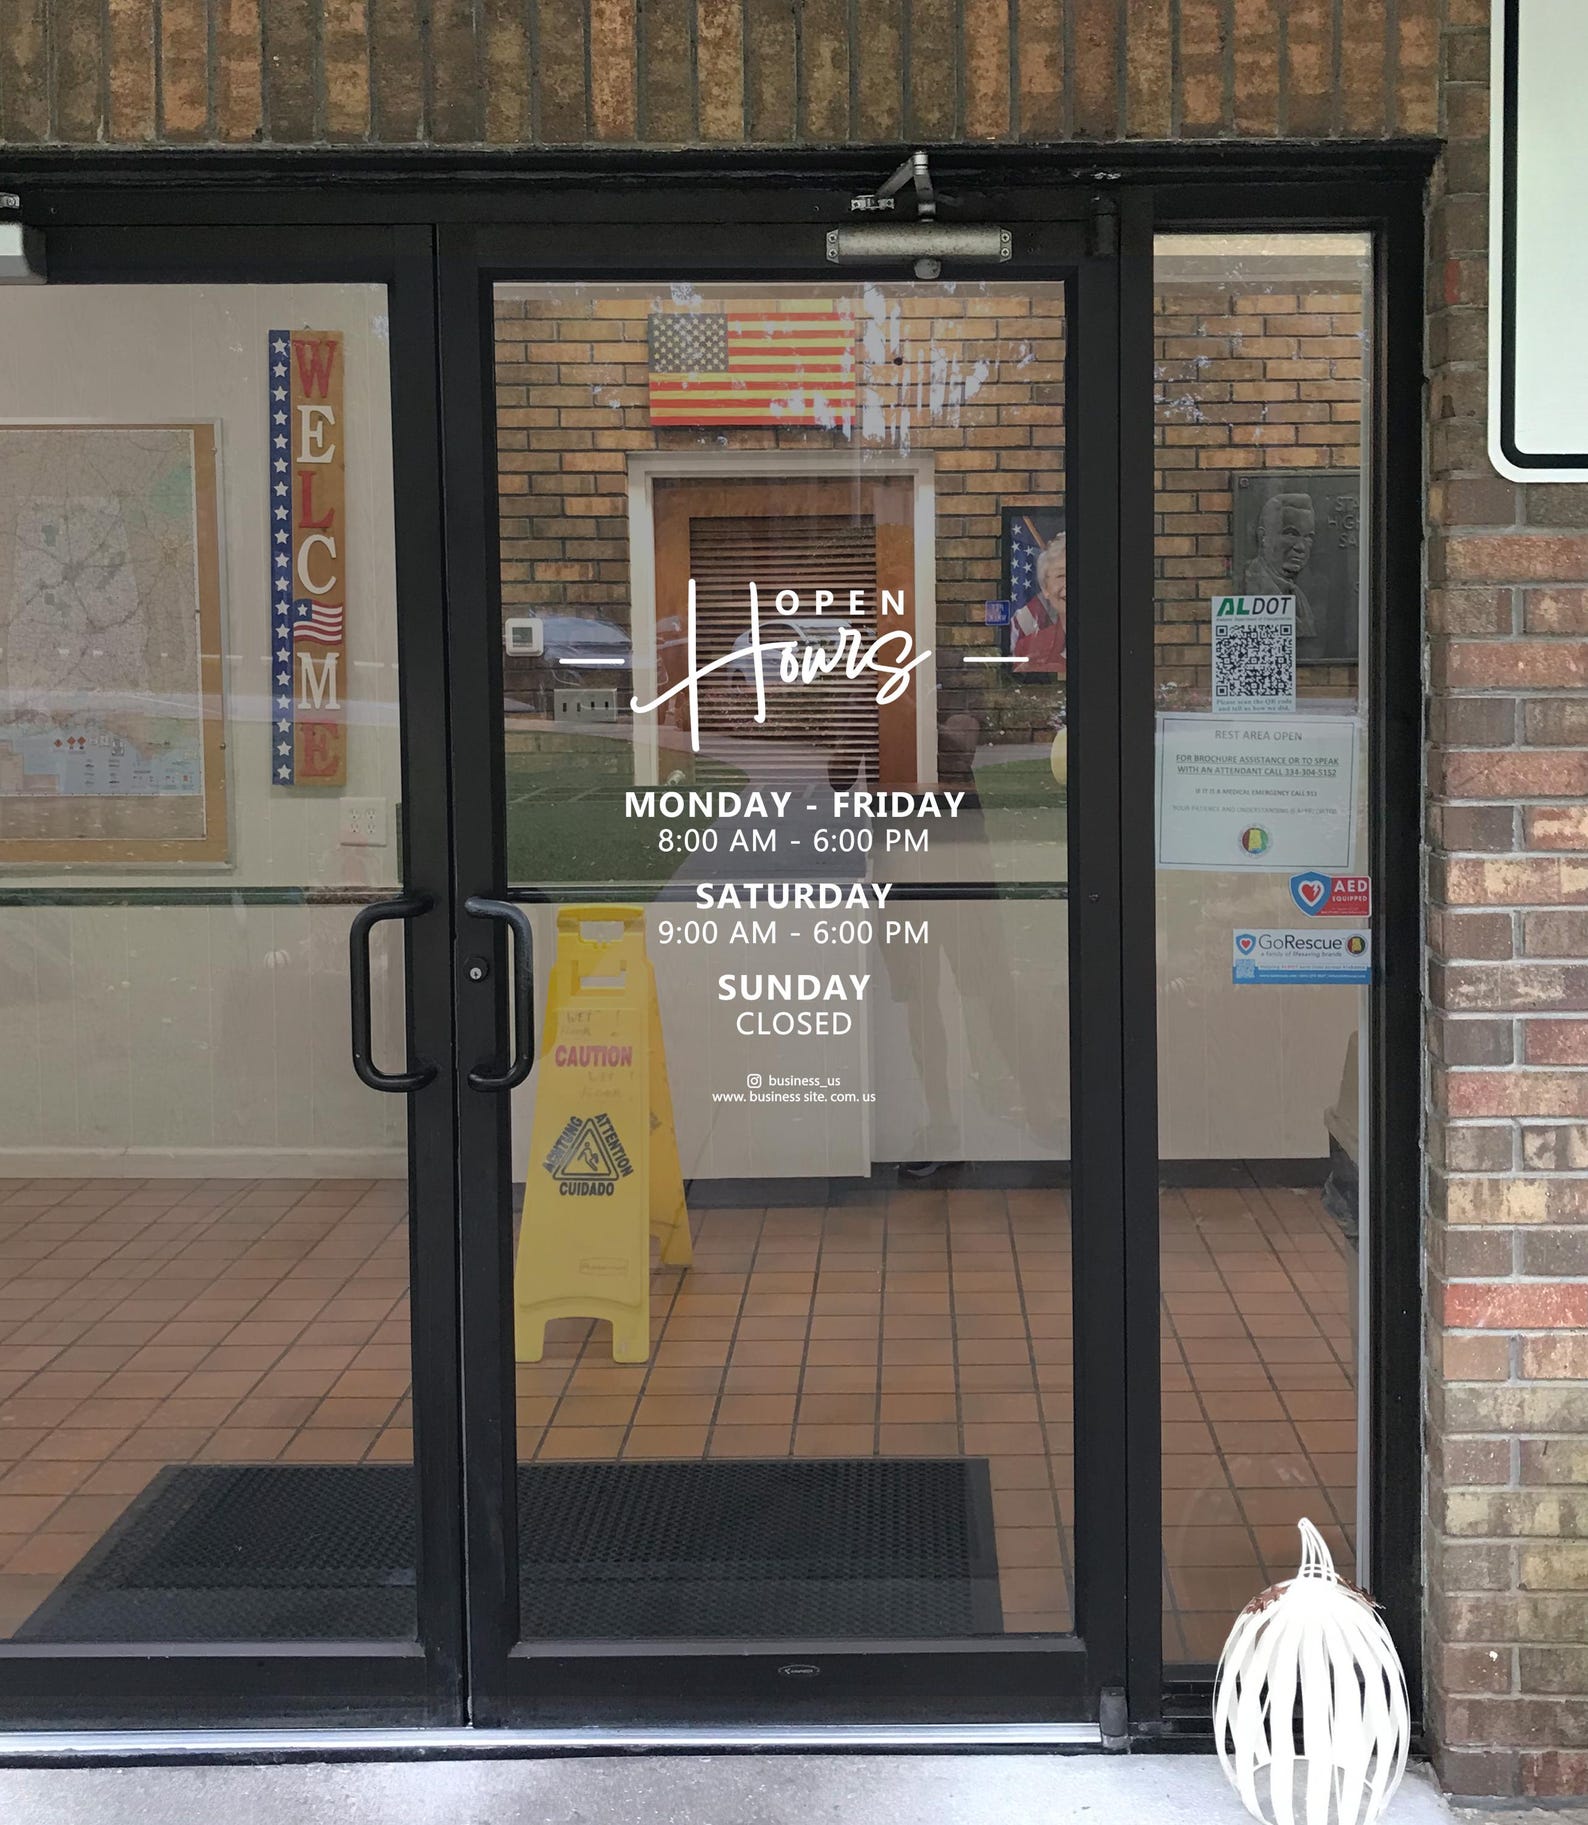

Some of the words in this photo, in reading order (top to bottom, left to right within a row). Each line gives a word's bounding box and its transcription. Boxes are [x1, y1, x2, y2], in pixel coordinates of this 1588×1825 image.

[774, 589, 905, 616] OPEN
[1216, 597, 1292, 616] ALDOT
[630, 578, 932, 752] Hours
[1215, 729, 1239, 740] REST
[1243, 730, 1270, 741] AREA
[1273, 731, 1303, 741] OPEN
[1176, 754, 1192, 762] FOR
[1194, 755, 1237, 763] BROCHURE
[1239, 756, 1286, 764] ASSISTANCE
[1302, 757, 1313, 765] TO
[1314, 757, 1339, 765] SPEAK
[1177, 765, 1199, 773] WITH
[1201, 766, 1213, 774] AN
[1215, 767, 1262, 775] ATTENDANT
[1264, 768, 1282, 776] CALL
[1251, 789, 1289, 797] EMERGENCY
[625, 791, 792, 818] MONDAY
[834, 791, 965, 818] FRIDAY
[658, 828, 718, 852] 8:00
[729, 829, 776, 852] AM
[814, 828, 873, 852] 6:00
[886, 829, 928, 852] PM
[696, 883, 893, 909] SATURDAY
[1334, 880, 1368, 893] AED
[658, 920, 718, 944] 9:00
[729, 921, 776, 944] AM
[813, 920, 873, 944] 6:00
[886, 921, 928, 944] PM
[1258, 934, 1343, 950] GoRescue
[718, 974, 870, 1001] SUNDAY
[736, 1011, 852, 1035] CLOSED
[555, 1045, 633, 1067] CAUTION
[768, 1074, 841, 1088] business_us
[712, 1093, 747, 1102] www.
[749, 1091, 801, 1102] business
[804, 1091, 828, 1102] site.
[831, 1093, 860, 1102] com.
[862, 1093, 876, 1102] us
[542, 1116, 583, 1174] ACHTUNG
[594, 1112, 634, 1178] ATTENTION
[559, 1181, 615, 1197] CUIDADO
